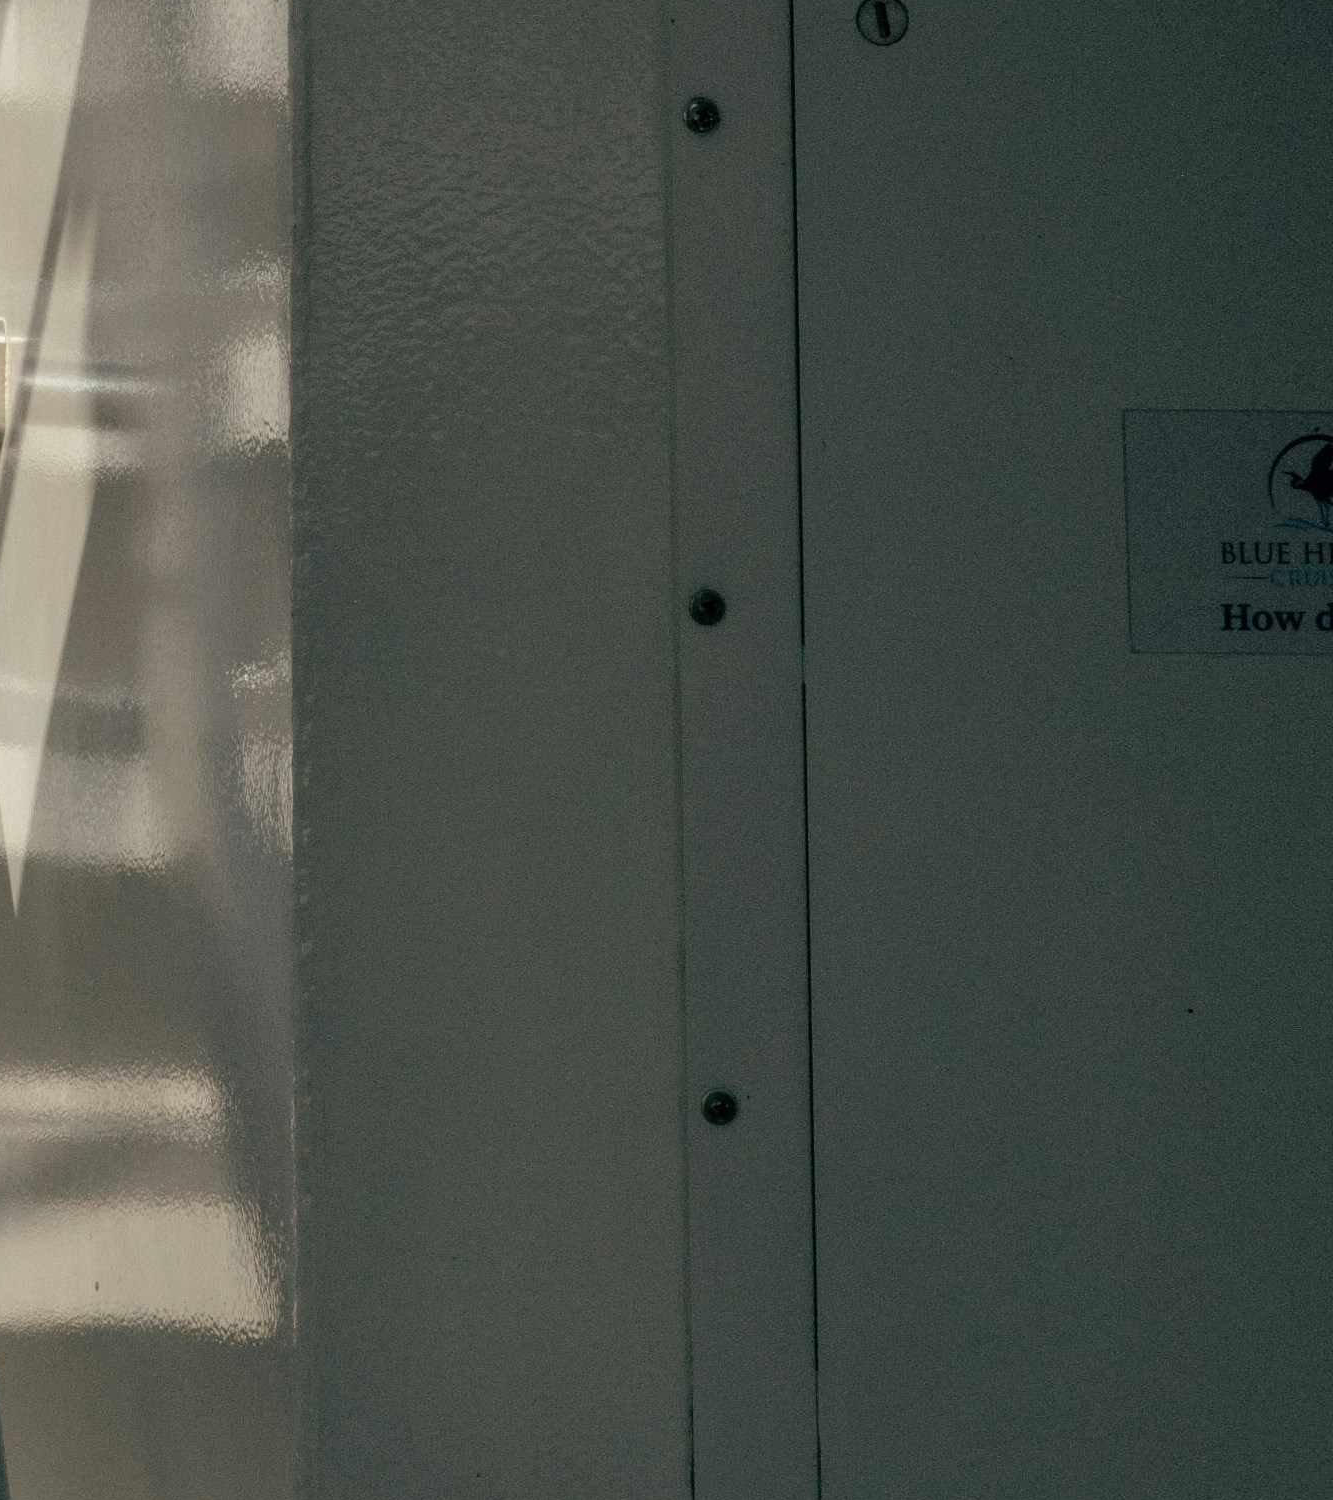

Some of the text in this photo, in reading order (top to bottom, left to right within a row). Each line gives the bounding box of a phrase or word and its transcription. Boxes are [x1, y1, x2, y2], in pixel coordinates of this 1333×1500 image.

[1220, 541, 1333, 565] BLUE H
[1220, 603, 1306, 631] How
